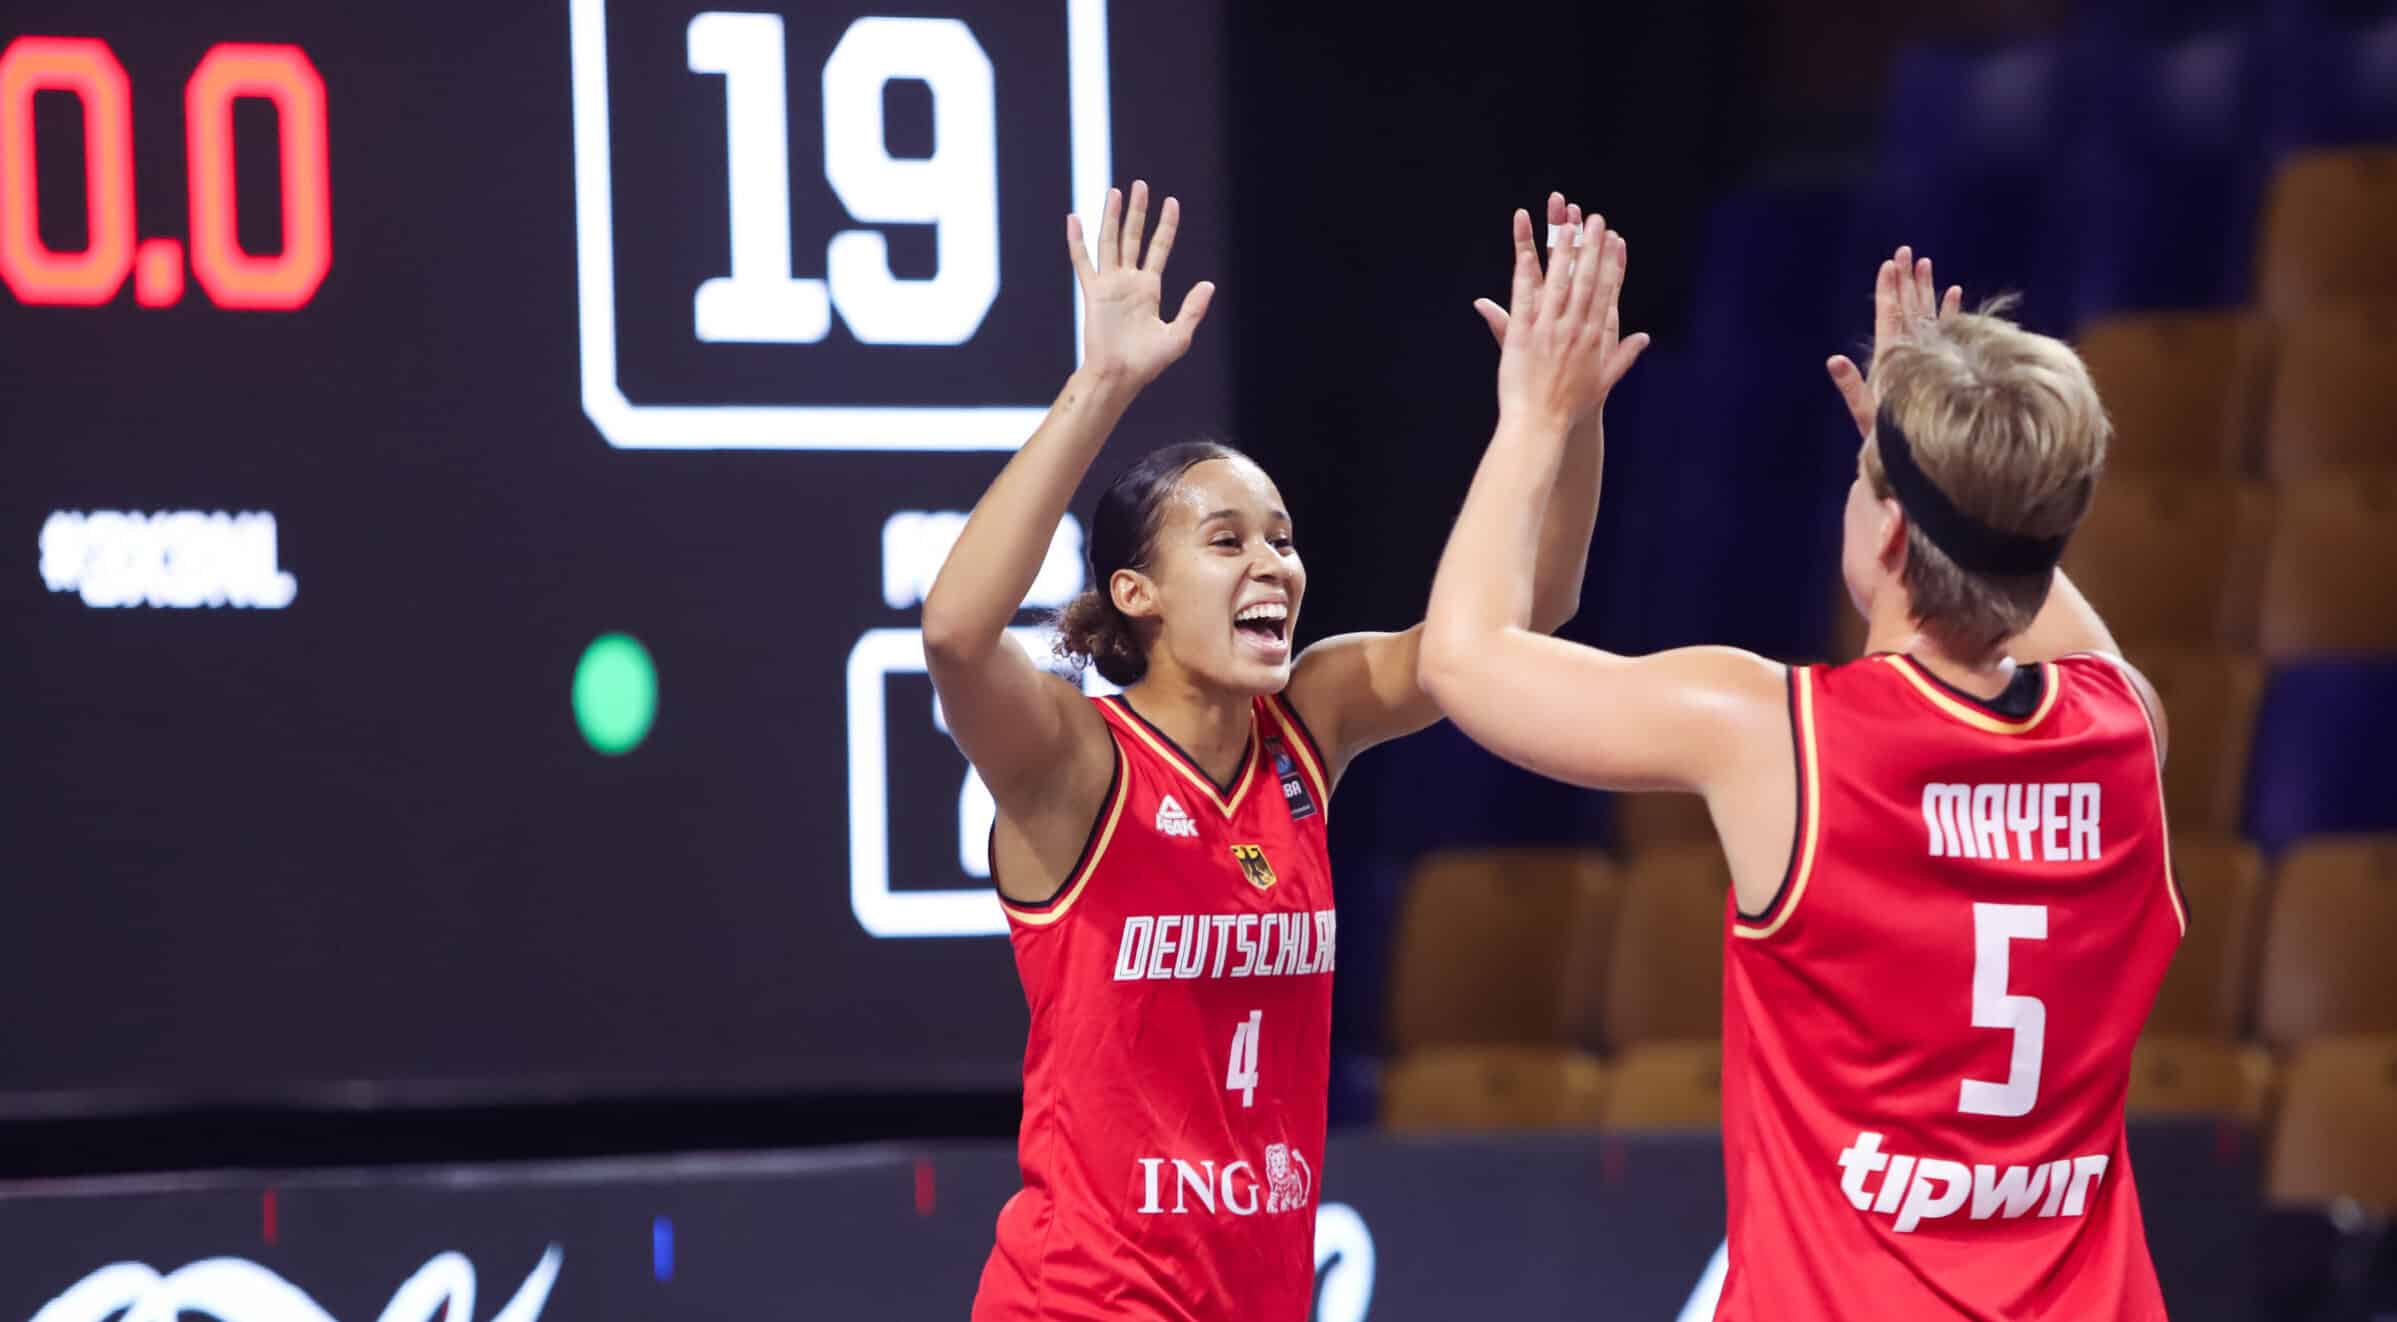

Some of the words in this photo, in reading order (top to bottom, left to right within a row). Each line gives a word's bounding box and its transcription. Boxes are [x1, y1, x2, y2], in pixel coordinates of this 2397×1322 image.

[686, 11, 1000, 346] 19
[1283, 780, 1302, 798] BA
[1921, 782, 2102, 862] MAYER
[1113, 908, 1337, 981] DEUTSCHLA
[1957, 901, 2049, 1118] 5
[1225, 1009, 1263, 1108] 4
[1136, 1157, 1261, 1216] ING
[1837, 1131, 2110, 1233] tipwin
